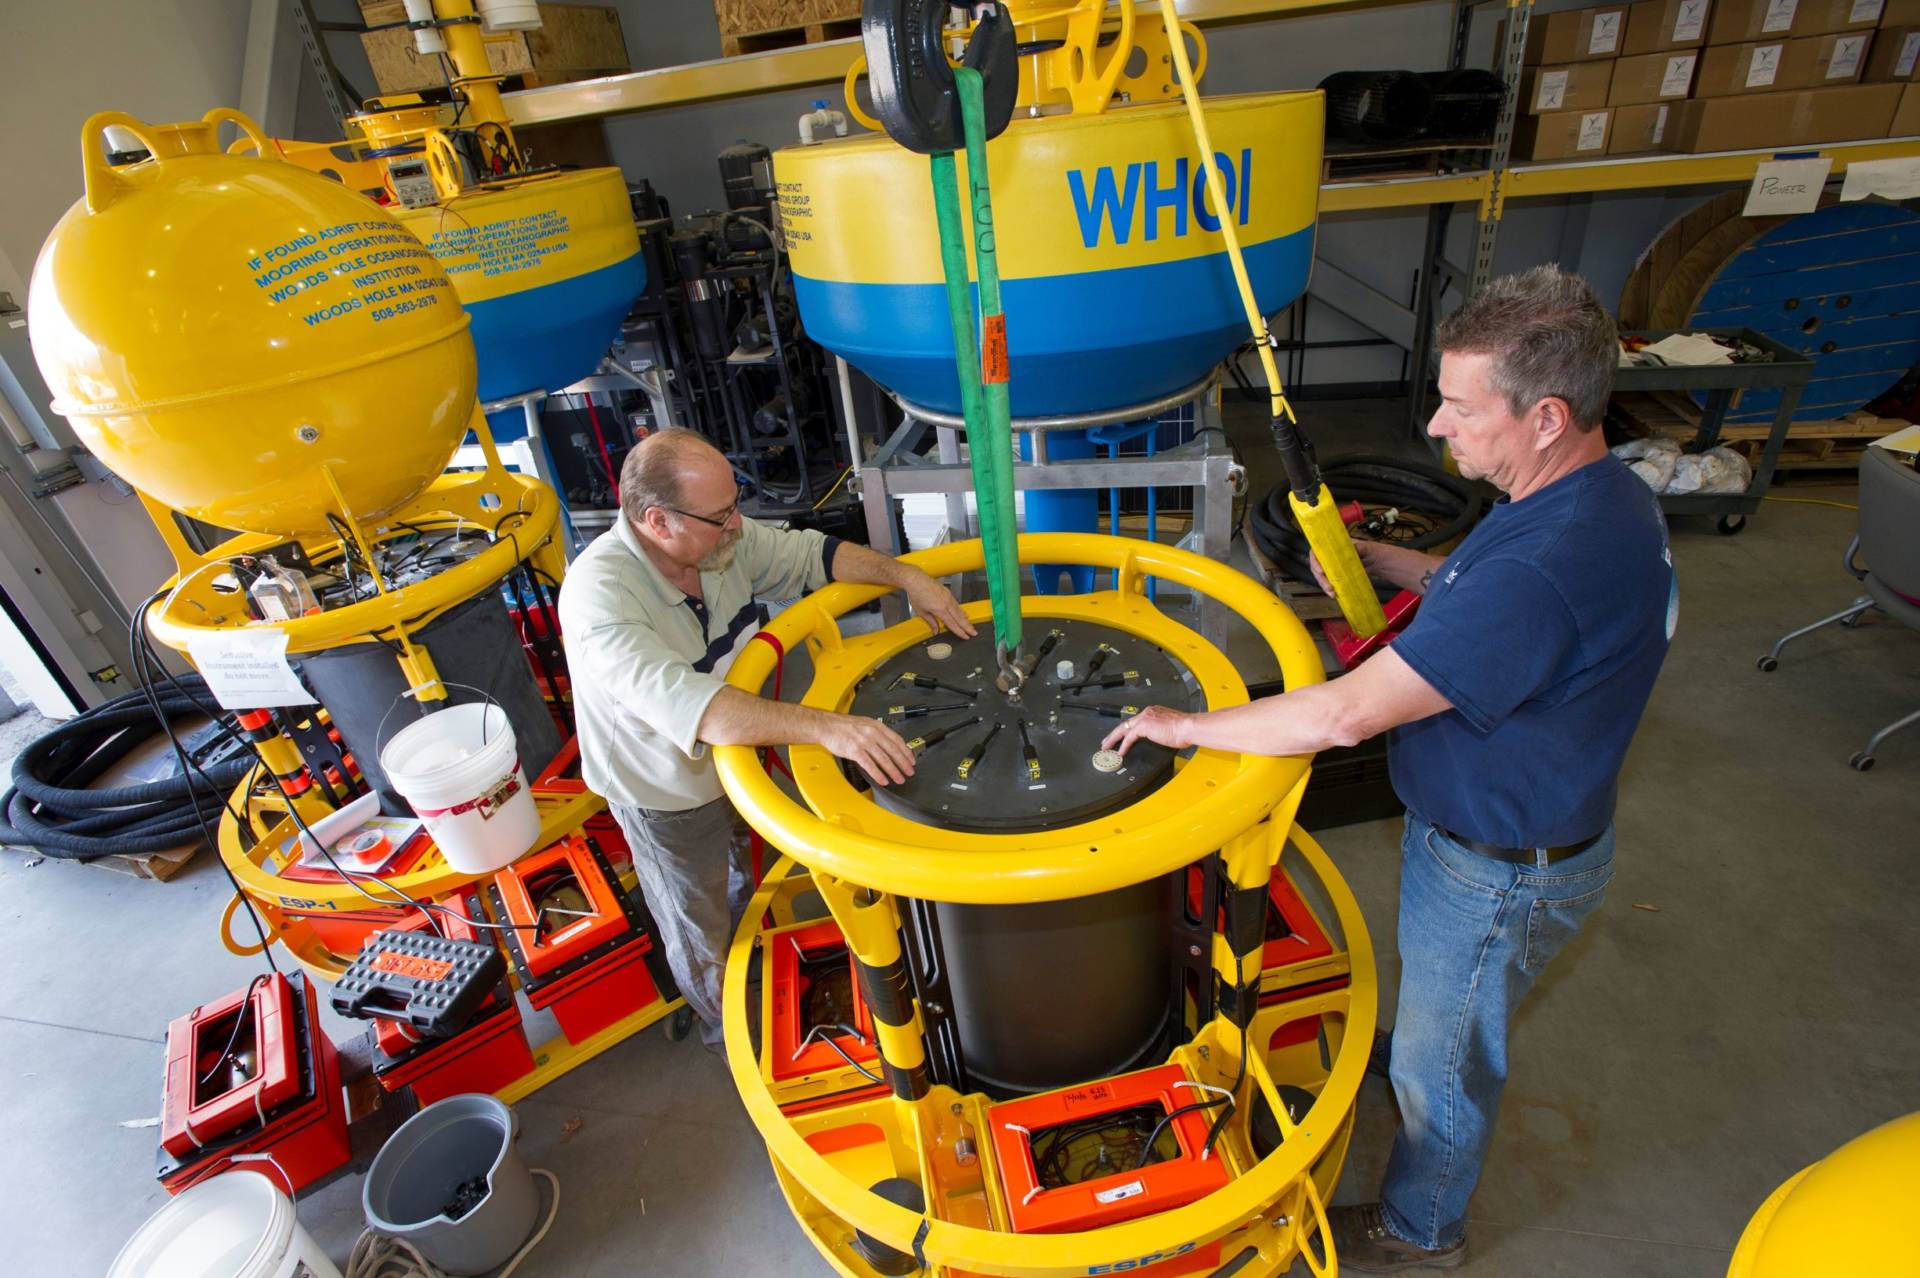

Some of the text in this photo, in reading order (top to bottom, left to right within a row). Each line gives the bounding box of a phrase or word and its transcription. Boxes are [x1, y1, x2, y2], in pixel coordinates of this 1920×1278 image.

[1066, 148, 1252, 248] WHOI
[432, 210, 558, 241] IF FOUND ADRIFT CONTACT
[479, 224, 538, 242] OPERATIONS
[539, 216, 568, 230] GROUP
[247, 257, 263, 271] IF
[264, 234, 317, 262] FOUND
[318, 223, 362, 240] ADRIFT
[431, 225, 570, 259] OODS HOLE OCEANOGRAPHIC
[479, 242, 536, 259] INSTITUTION
[483, 256, 509, 268] HOLE
[512, 253, 526, 262] MA
[552, 242, 569, 252] USA
[254, 250, 329, 288] MOORING
[328, 234, 398, 256] OPERATIONS
[352, 265, 421, 288] INSTITUTION
[269, 271, 329, 303] WOODS
[303, 297, 362, 327] WOODS
[363, 286, 398, 305] HOLE
[398, 281, 416, 294] MA
[279, 896, 337, 910] ESP-1
[1087, 1241, 1196, 1275] ESP-2
